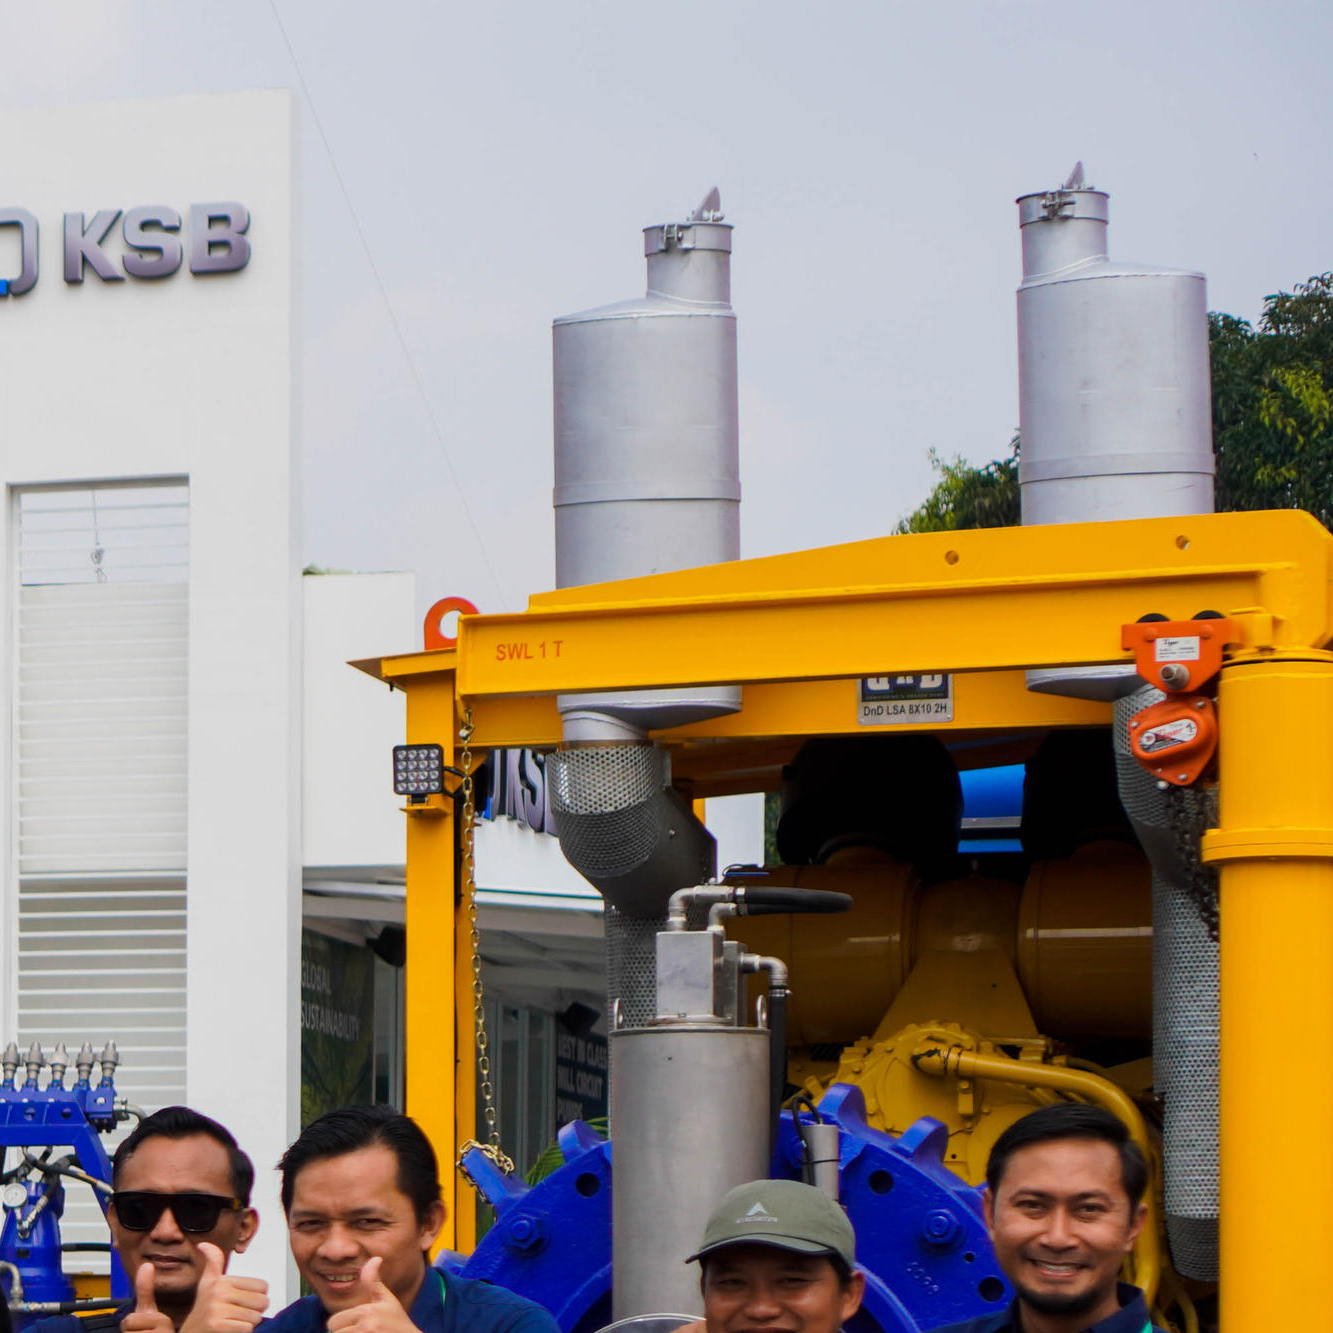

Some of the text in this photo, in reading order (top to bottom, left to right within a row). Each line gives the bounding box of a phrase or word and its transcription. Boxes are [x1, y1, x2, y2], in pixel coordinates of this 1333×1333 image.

[63, 201, 251, 284] KSB
[495, 640, 564, 661] SWL 1 T
[863, 702, 947, 717] DnD LSA 8X10 2H
